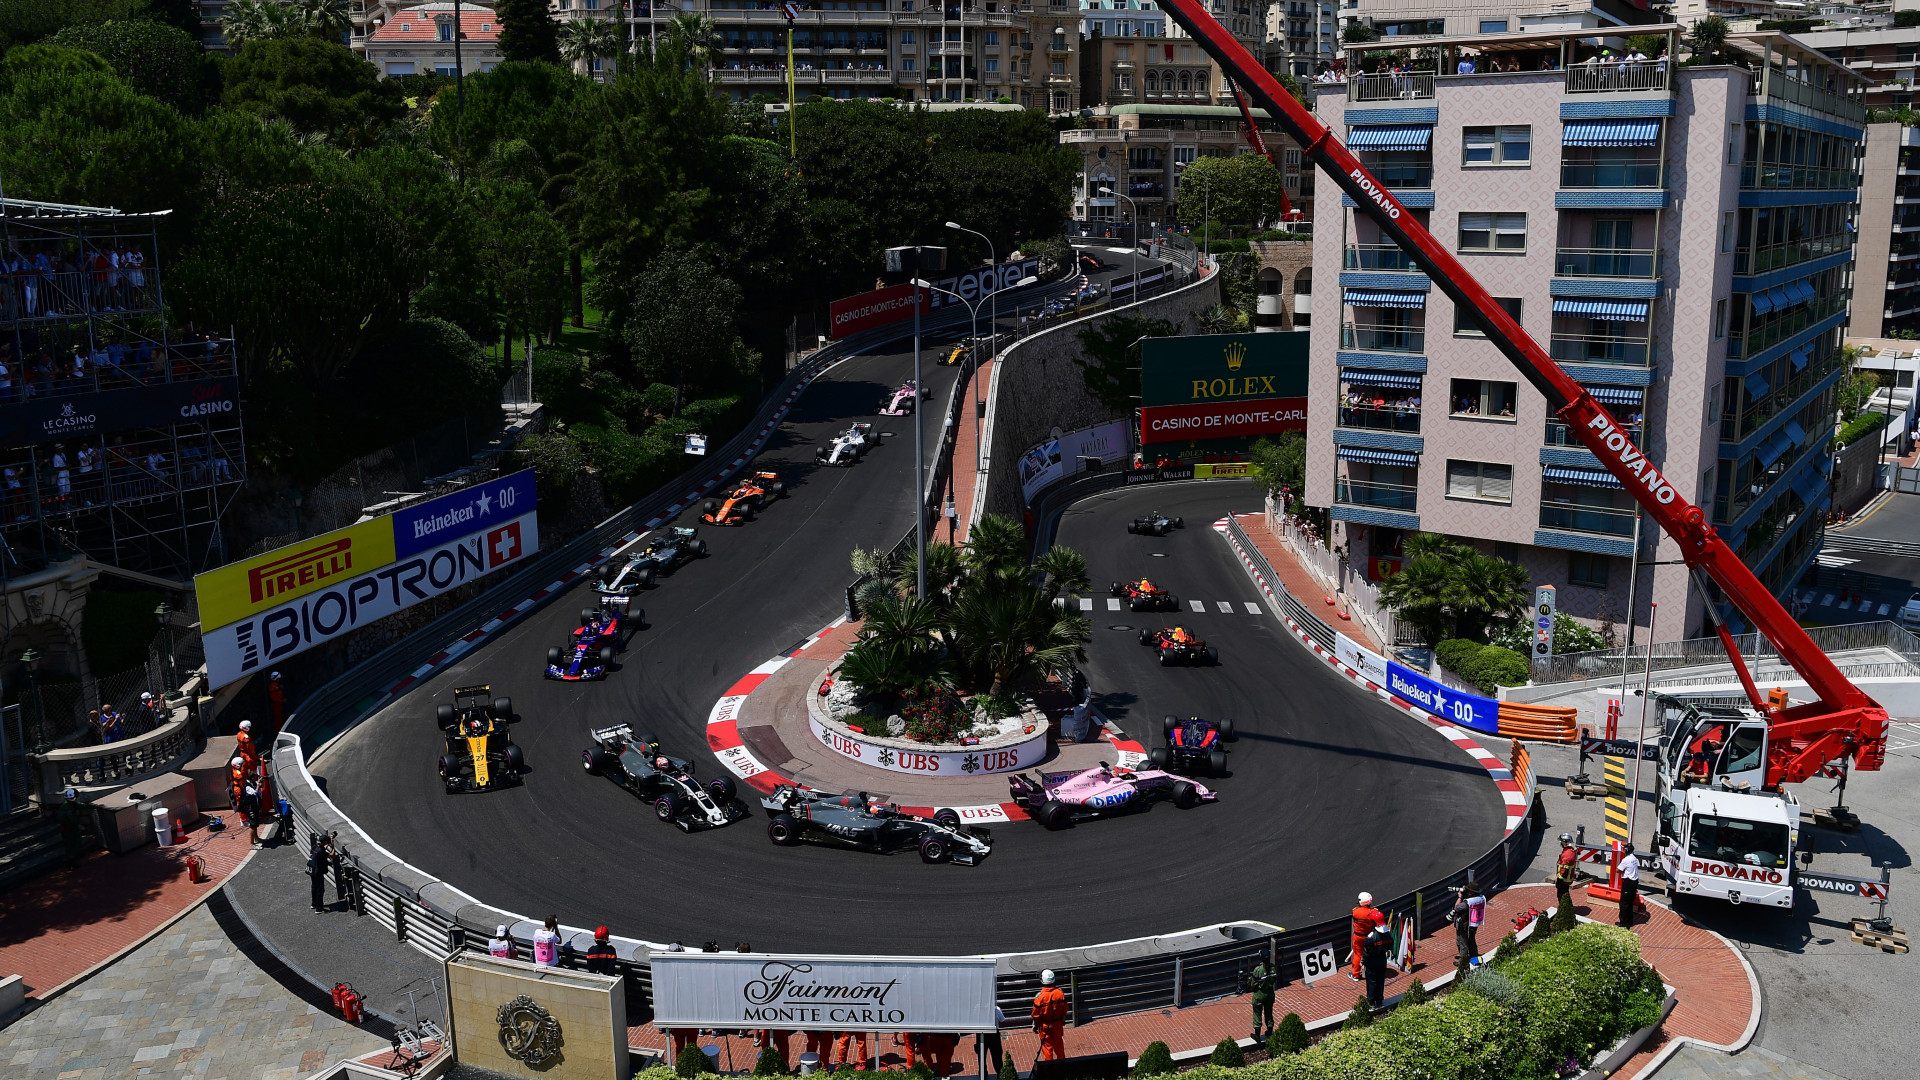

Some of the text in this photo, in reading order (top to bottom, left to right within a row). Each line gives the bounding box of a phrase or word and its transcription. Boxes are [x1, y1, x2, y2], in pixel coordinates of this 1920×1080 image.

[1350, 168, 1400, 219] PIOVANO
[835, 294, 924, 325] CASINO DE MONTE-CARO
[1192, 376, 1276, 398] ROLEX
[180, 400, 233, 417] CASINO
[1152, 409, 1308, 430] CASINO DE MONTE-CARL
[43, 414, 97, 430] LE CASINO
[1211, 464, 1248, 475] PIRELLI
[1588, 413, 1675, 504] PIOVANO
[1127, 470, 1191, 485] JOHNNIE WALKER
[499, 486, 515, 510] 0.0
[413, 506, 474, 539] Heineken
[248, 537, 352, 604] PIRELLI
[261, 534, 485, 661] BIOPTRON
[1391, 673, 1432, 706] Heineken
[717, 703, 736, 721] UBS
[1454, 700, 1473, 723] 0.0
[832, 733, 862, 758] UBS
[732, 755, 760, 776] UBS
[898, 752, 940, 771] UBS
[983, 749, 1018, 771] UBS
[1105, 790, 1133, 807] BWT
[961, 807, 1003, 819] UBS
[824, 823, 865, 838] HAAS
[1690, 860, 1783, 884] PIOVANO
[1798, 877, 1856, 893] PIOVANO
[1305, 949, 1332, 976] SC
[743, 961, 902, 1006] Fairmont
[743, 1007, 905, 1024] MONTE CARLO
